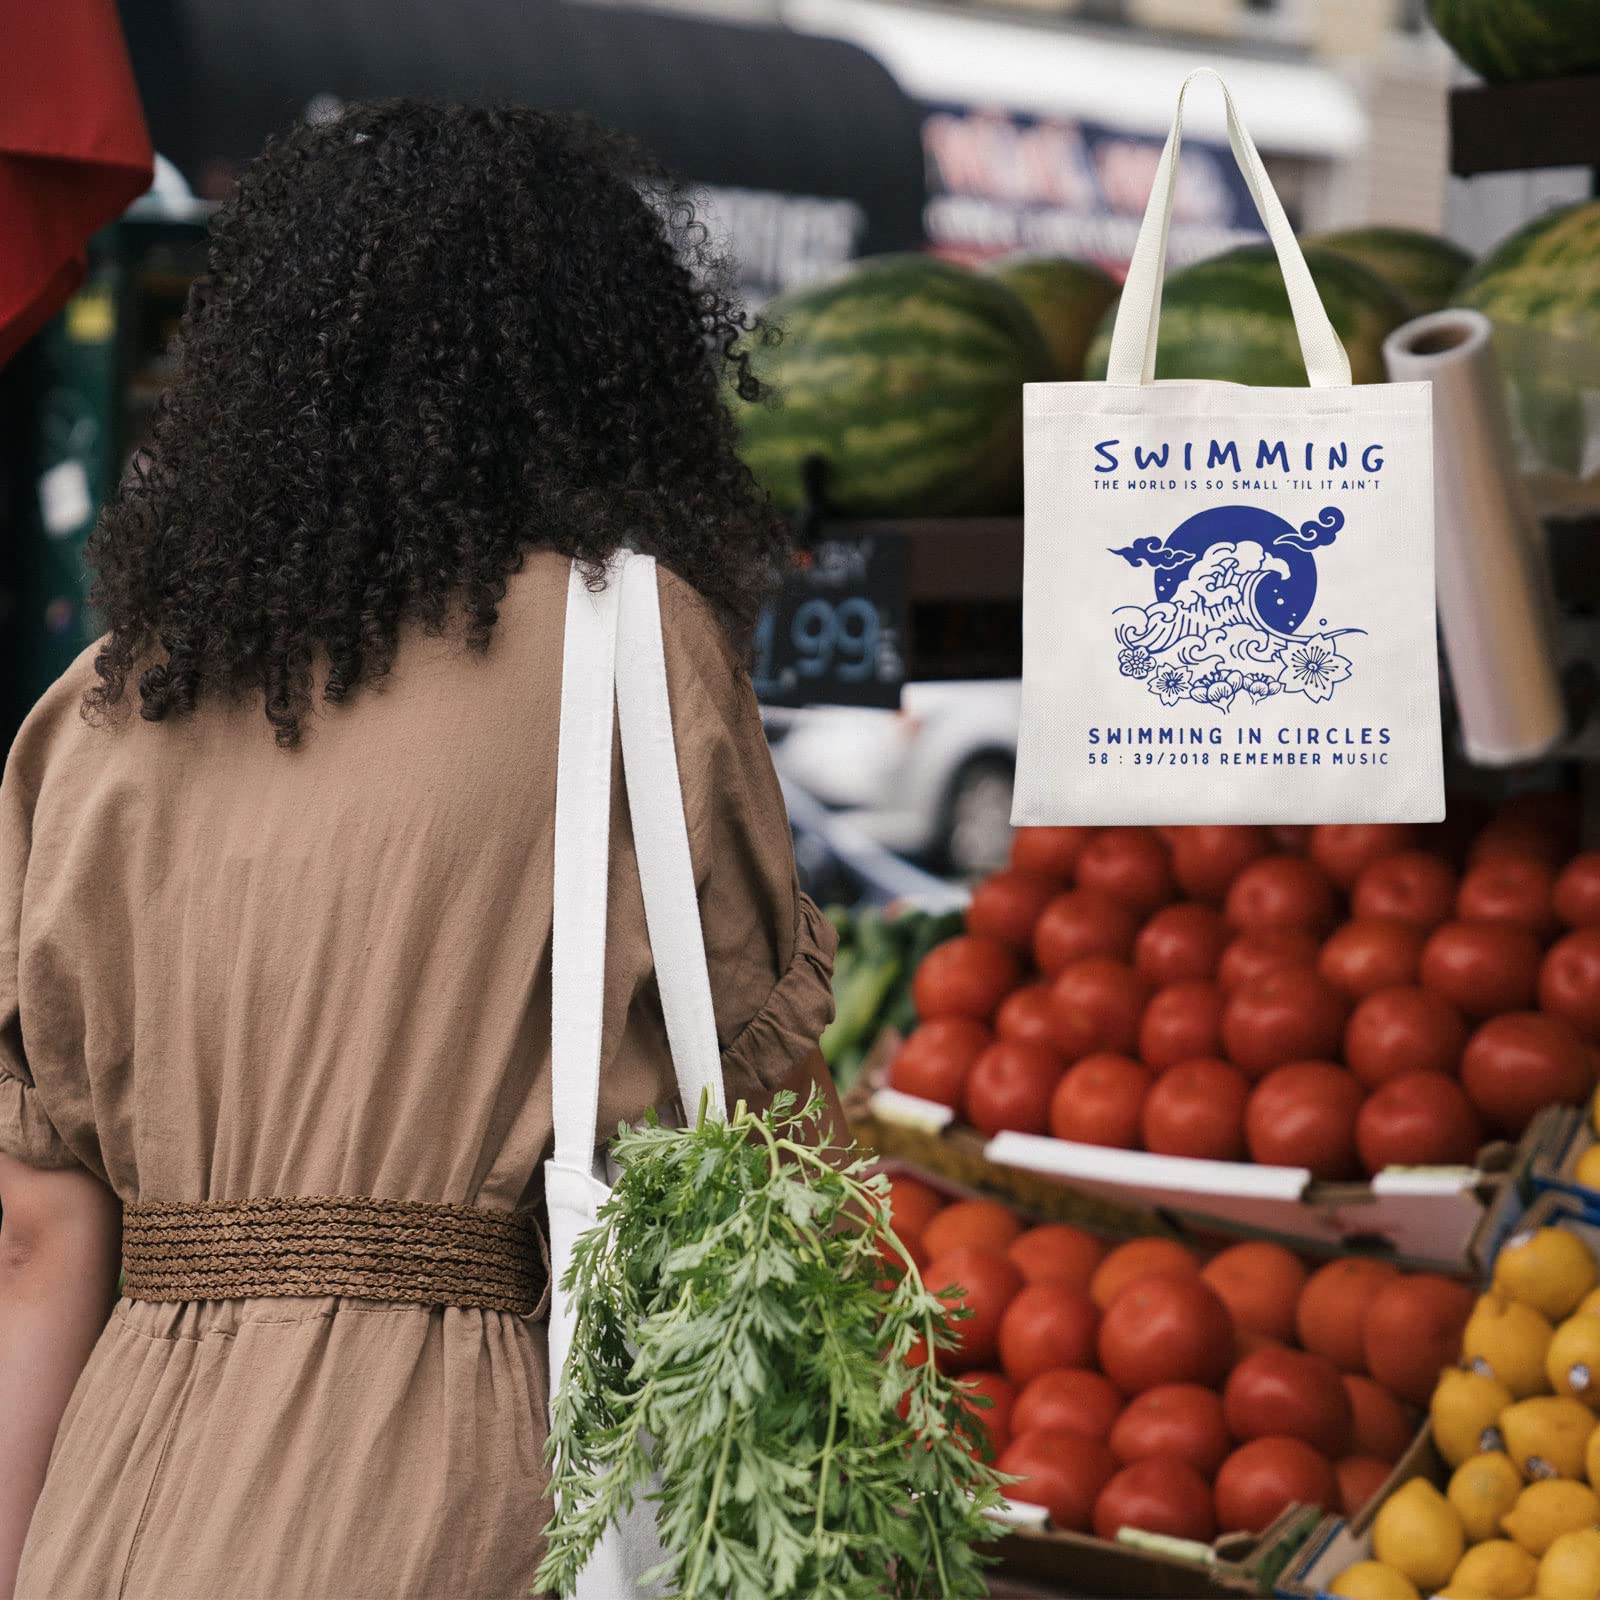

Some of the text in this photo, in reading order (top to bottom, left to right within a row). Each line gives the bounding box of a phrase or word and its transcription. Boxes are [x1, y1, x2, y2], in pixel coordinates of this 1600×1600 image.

[1093, 439, 1385, 474] SWIMMING
[1093, 479, 1119, 490] THE
[1127, 479, 1177, 490] WORLD
[1184, 479, 1197, 490] IS
[1205, 479, 1224, 490] SO
[1232, 479, 1278, 490] SMALL
[1321, 479, 1333, 490] IT
[1088, 727, 1391, 745] SWIMMING IN CIRCLES
[1220, 752, 1321, 765] REMEMBER
[1332, 752, 1389, 765] MUSIC
